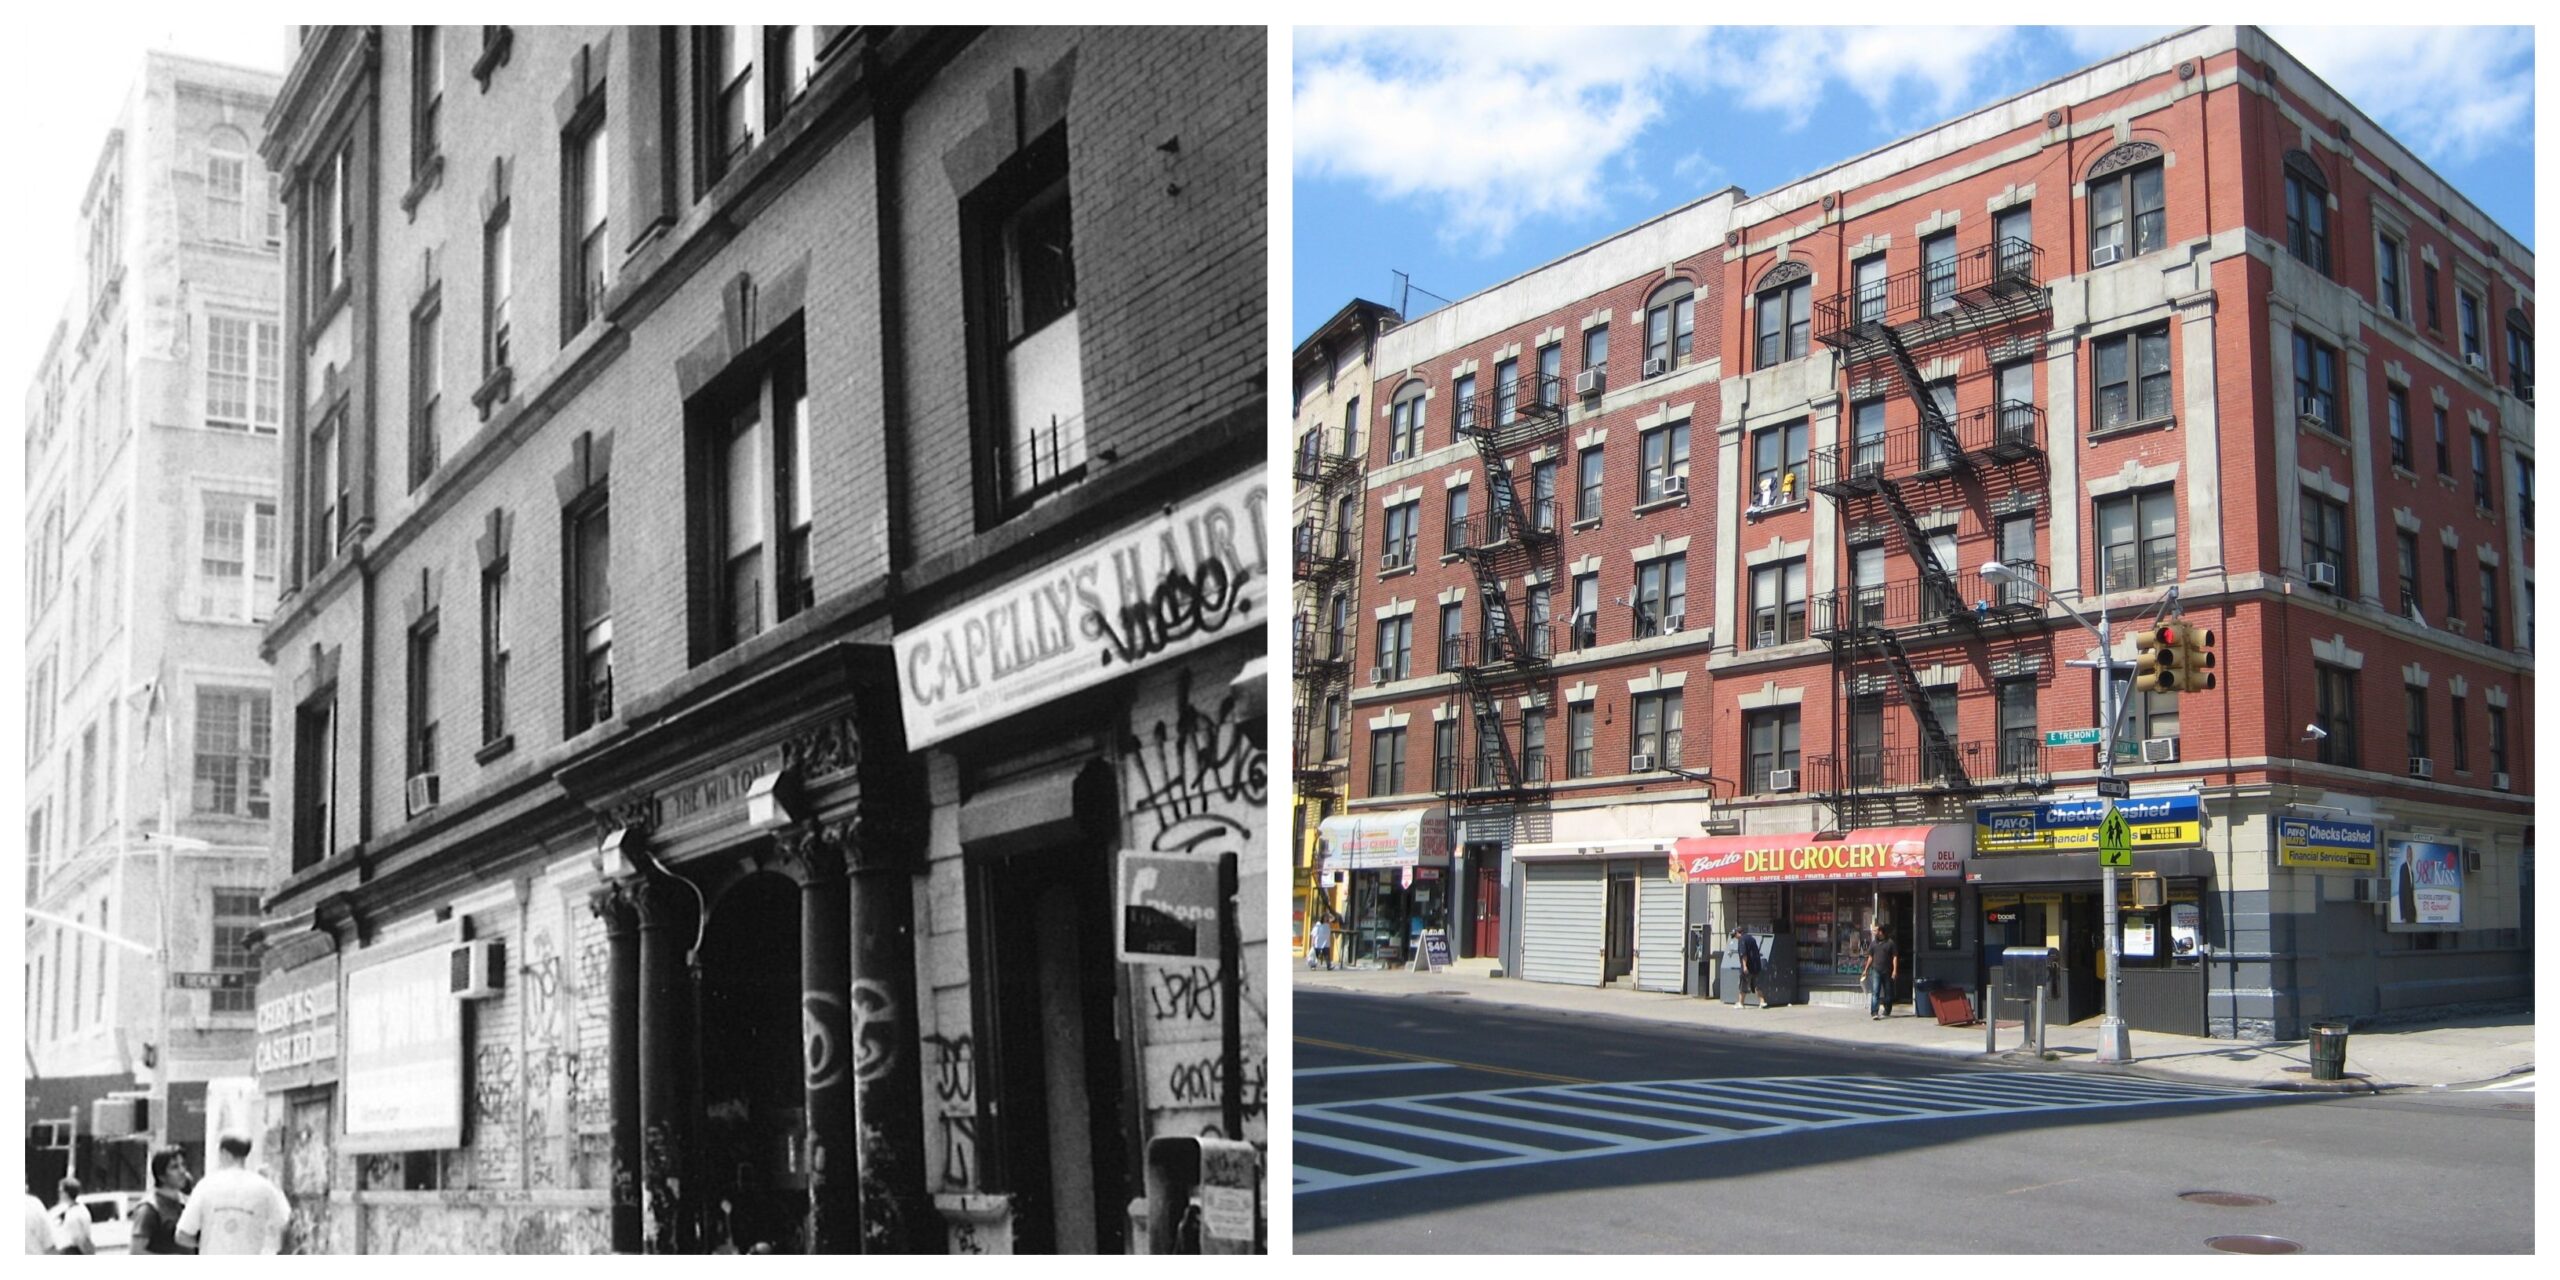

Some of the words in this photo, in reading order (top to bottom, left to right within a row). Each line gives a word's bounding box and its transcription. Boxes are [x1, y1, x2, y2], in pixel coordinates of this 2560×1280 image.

[908, 560, 1101, 706] CAPELLY'S
[1111, 505, 1245, 613] HAIR
[2051, 732, 2055, 740] E
[2060, 730, 2095, 739] TREMONT
[674, 785, 698, 819] THE
[703, 761, 766, 807] WILTON
[2047, 809, 2103, 824] Checks
[2117, 802, 2170, 819] ashed
[2044, 833, 2089, 844] Financial
[2141, 827, 2175, 835] WESTERN
[2309, 825, 2340, 840] Checks
[2341, 828, 2371, 843] Cashed
[1689, 851, 1742, 874] Benito
[1744, 848, 1785, 873] DELI
[1789, 843, 1889, 870] GROCERY
[1938, 851, 1954, 859] DELI
[2289, 850, 2318, 861] Financial
[2320, 851, 2347, 862] Services
[1932, 861, 1960, 871] GROCERY
[1428, 942, 1446, 951] $40
[258, 988, 313, 1034] CHECKS
[256, 1031, 314, 1073] CASHED
